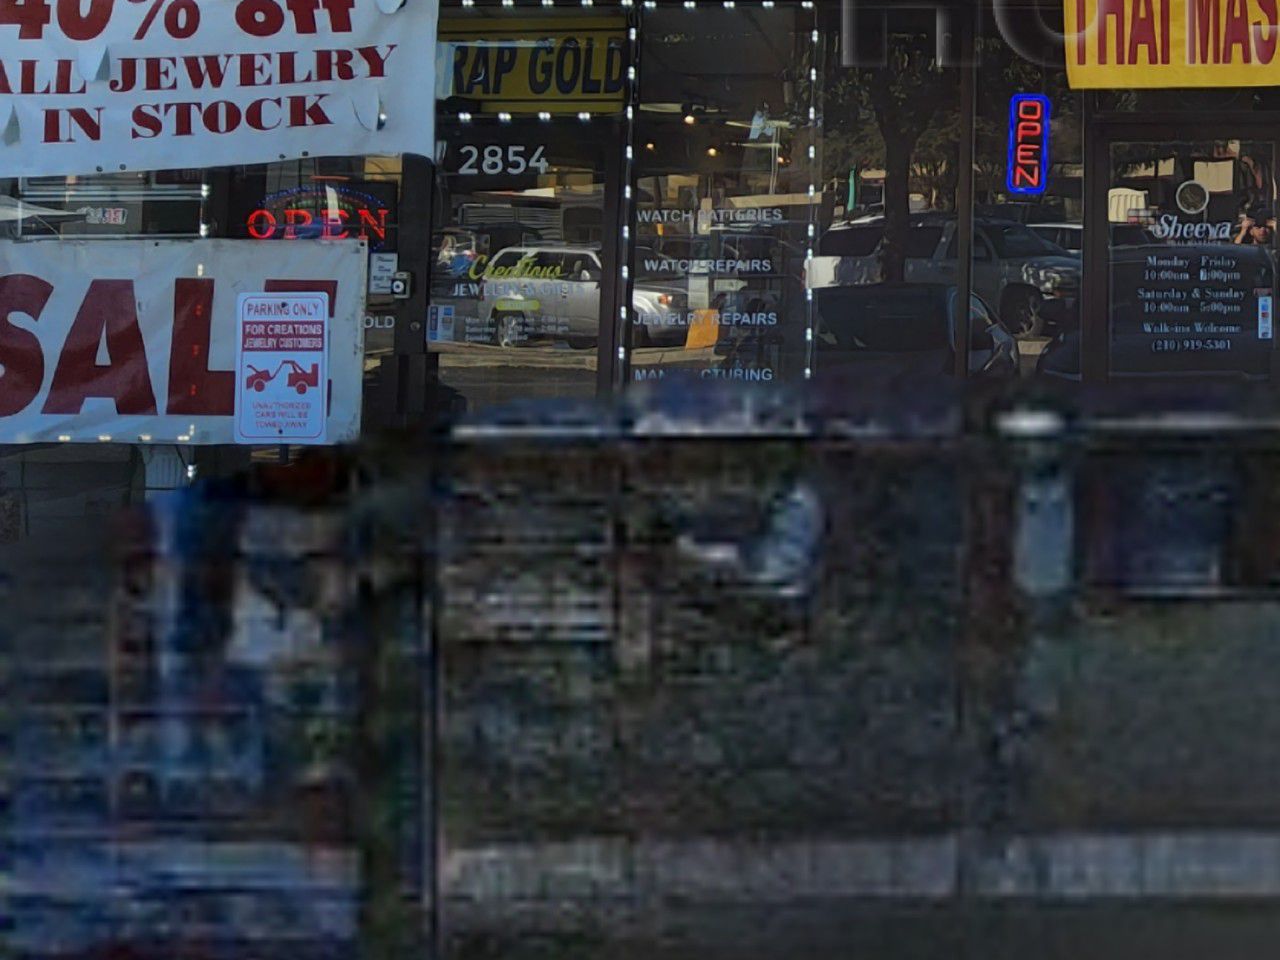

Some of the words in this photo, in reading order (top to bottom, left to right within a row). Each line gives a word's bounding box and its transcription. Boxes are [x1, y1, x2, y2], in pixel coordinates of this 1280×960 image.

[109, 44, 398, 93] JEWELRY
[528, 37, 626, 95] GOLD
[41, 107, 105, 143] IN
[131, 93, 334, 139] STOCK
[1014, 100, 1042, 187] OPEN
[458, 145, 549, 175] 2854
[636, 209, 693, 223] WATCH
[698, 208, 783, 222] BATTERIES
[247, 207, 389, 240] OPEN
[1150, 213, 1232, 239] Sheewa
[644, 259, 700, 272] WATCH
[704, 259, 772, 272] REPAIRS
[1146, 256, 1190, 269] Monday
[1201, 256, 1238, 269] Friday
[1137, 288, 1188, 300] Saturday
[1205, 288, 1245, 300] Sunday
[247, 303, 290, 316] PARKING
[292, 303, 319, 316] ONLY
[633, 313, 705, 326] JEWELRY
[711, 312, 777, 326] REPAIRS
[245, 324, 266, 335] FOR
[267, 324, 322, 335] CREATIONS
[634, 368, 773, 381] MANCTURING
